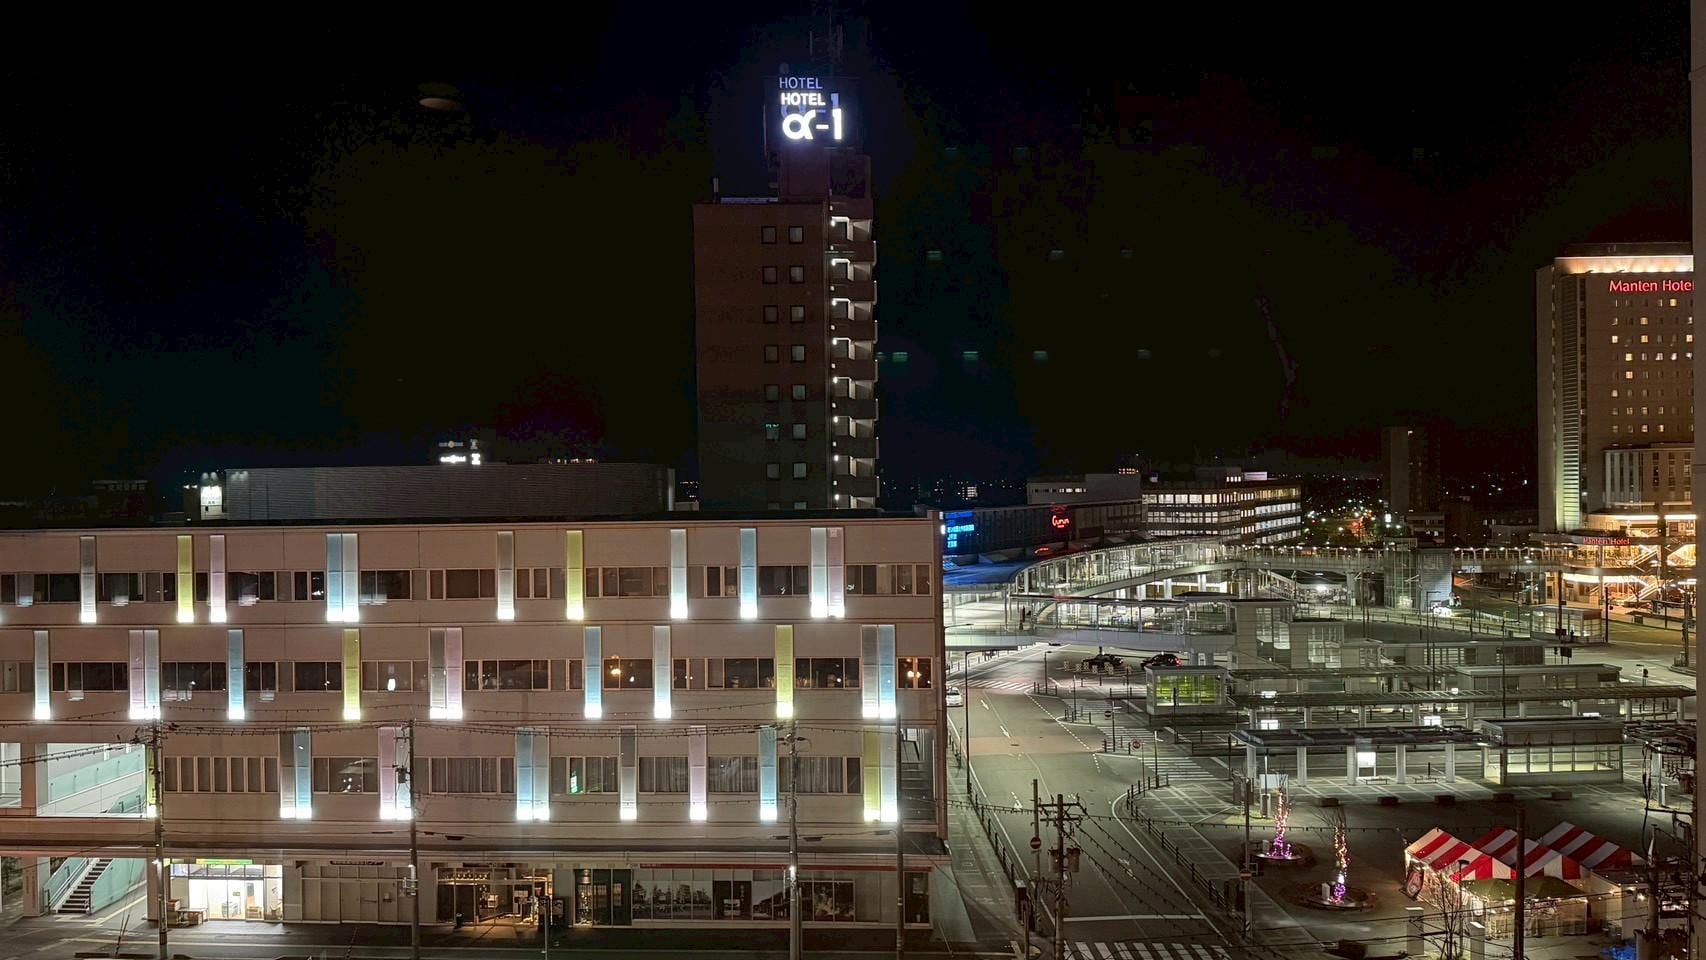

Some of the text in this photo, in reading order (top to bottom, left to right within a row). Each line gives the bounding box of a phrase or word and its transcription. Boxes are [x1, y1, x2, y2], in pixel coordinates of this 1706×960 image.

[779, 77, 823, 89] HOTEL
[781, 92, 826, 106] HOTEL
[1609, 279, 1695, 292] Manten Hotel
